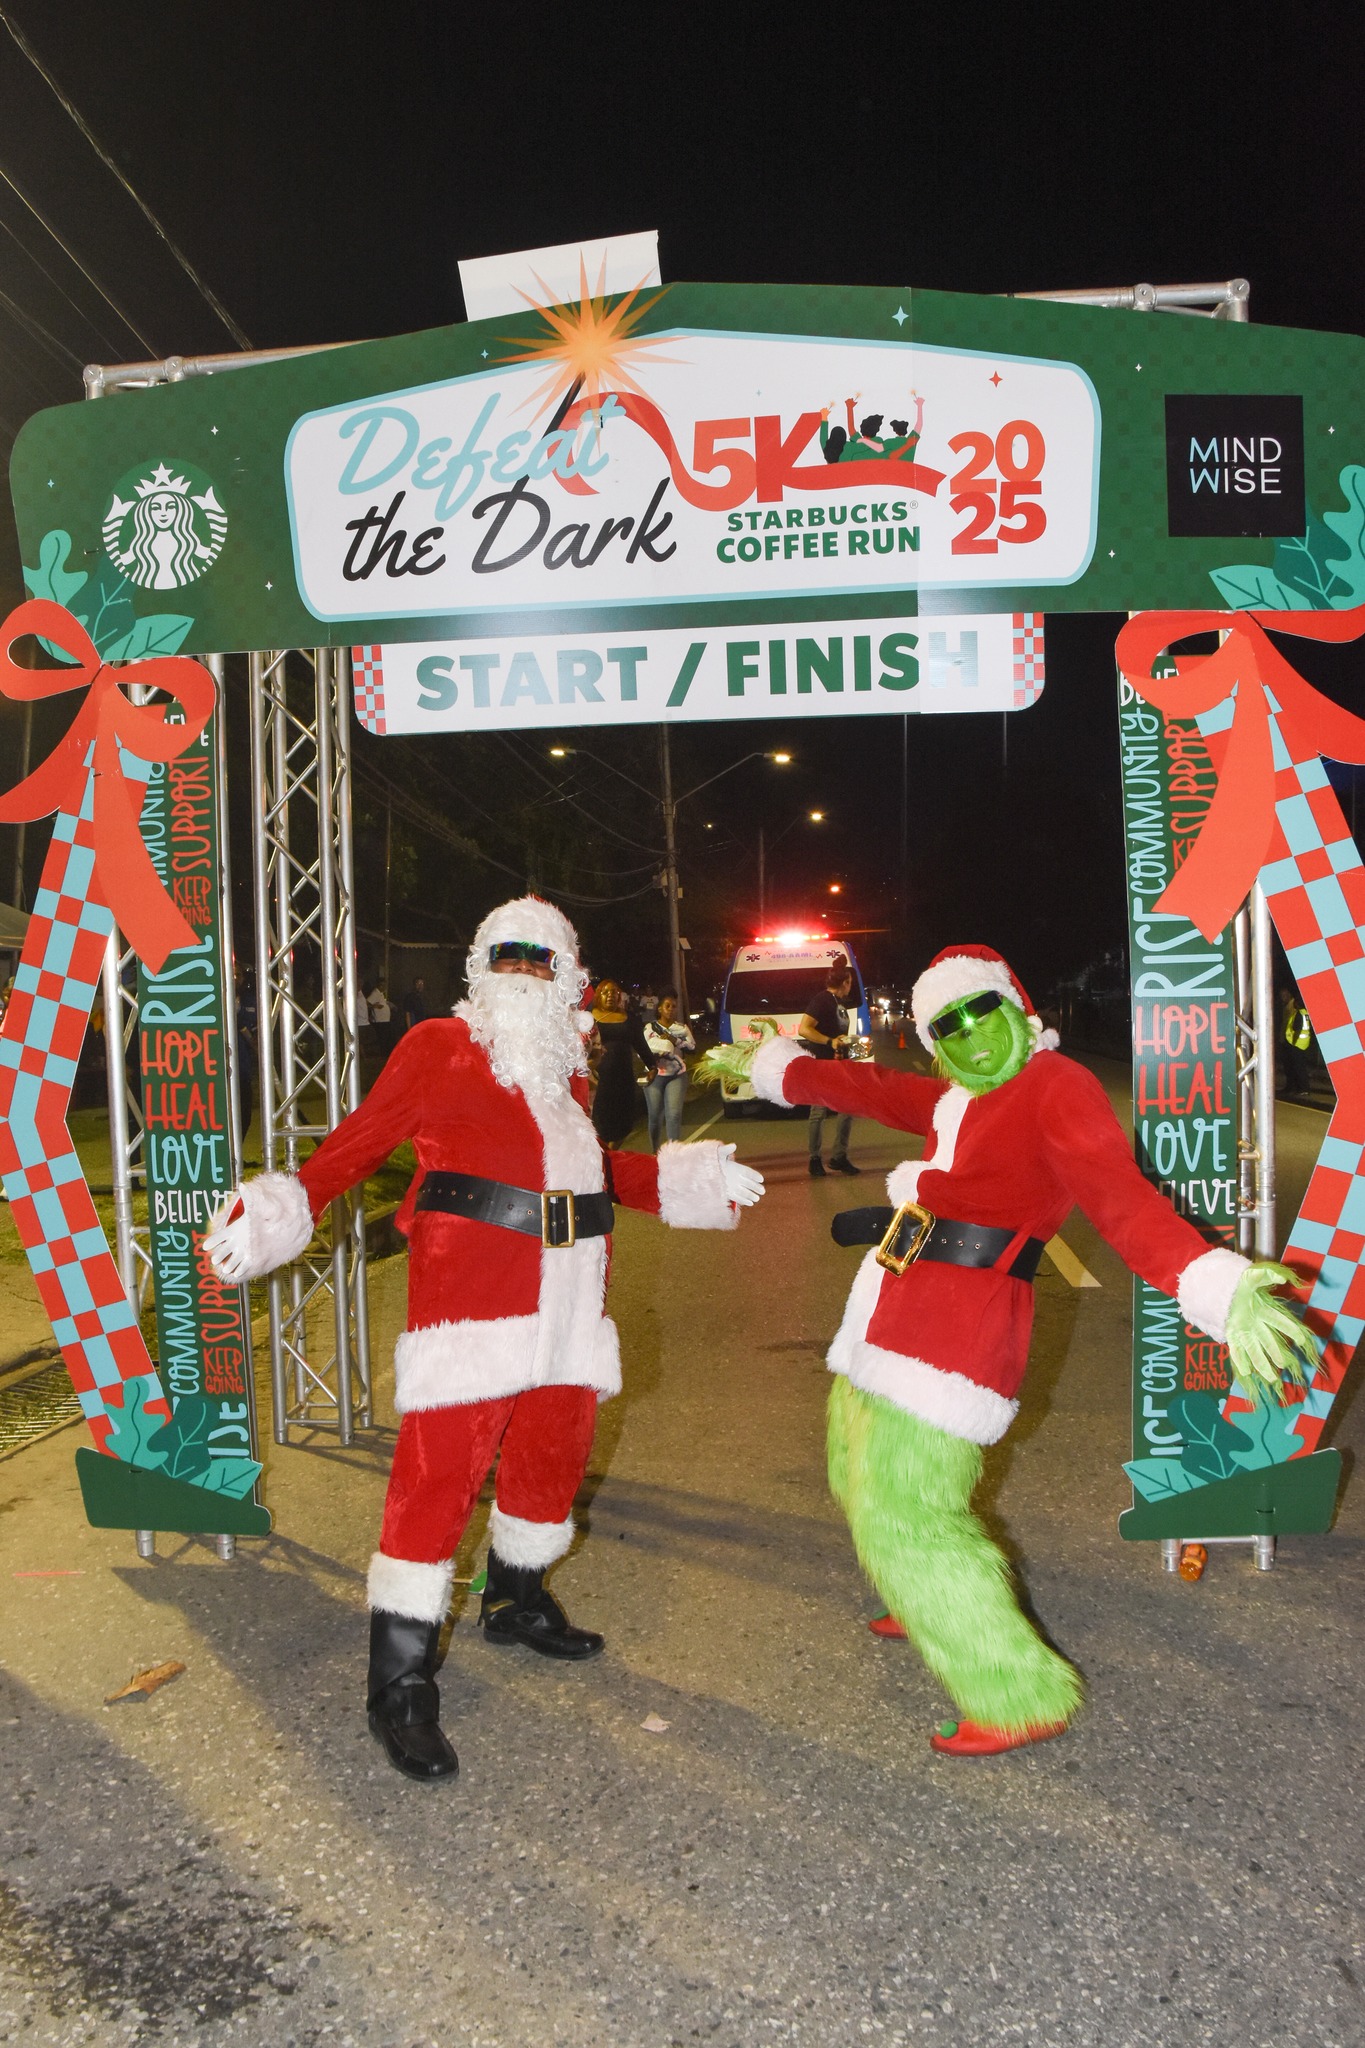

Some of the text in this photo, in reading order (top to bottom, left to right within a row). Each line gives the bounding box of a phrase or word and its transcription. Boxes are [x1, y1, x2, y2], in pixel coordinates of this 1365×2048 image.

[338, 392, 626, 522] Defeat
[680, 411, 824, 512] 5K
[1189, 437, 1282, 463] MIND
[1189, 468, 1282, 494] WISE
[343, 476, 677, 582] the Dark
[716, 526, 921, 564] COFFEE RUN
[416, 646, 648, 711] START
[726, 630, 979, 697] FINISH
[1121, 707, 1167, 894] COMMUNITY
[173, 875, 212, 906] KEEP
[181, 905, 213, 926] OING
[141, 1029, 218, 1078] HOPE
[1134, 1002, 1229, 1057] HOPE
[145, 1082, 223, 1131] HEAL
[1137, 1061, 1231, 1116] HEAL
[151, 1133, 224, 1185] LOVE
[1141, 1118, 1230, 1175] LOVE
[1158, 1177, 1237, 1216] LIEVE
[156, 1225, 200, 1395] COMMUNITY
[202, 1347, 243, 1375] KEEP
[1141, 1280, 1180, 1393] COMMU
[1184, 1341, 1230, 1371] KEEP
[204, 1374, 245, 1394] GOING
[1183, 1370, 1229, 1391] GOING
